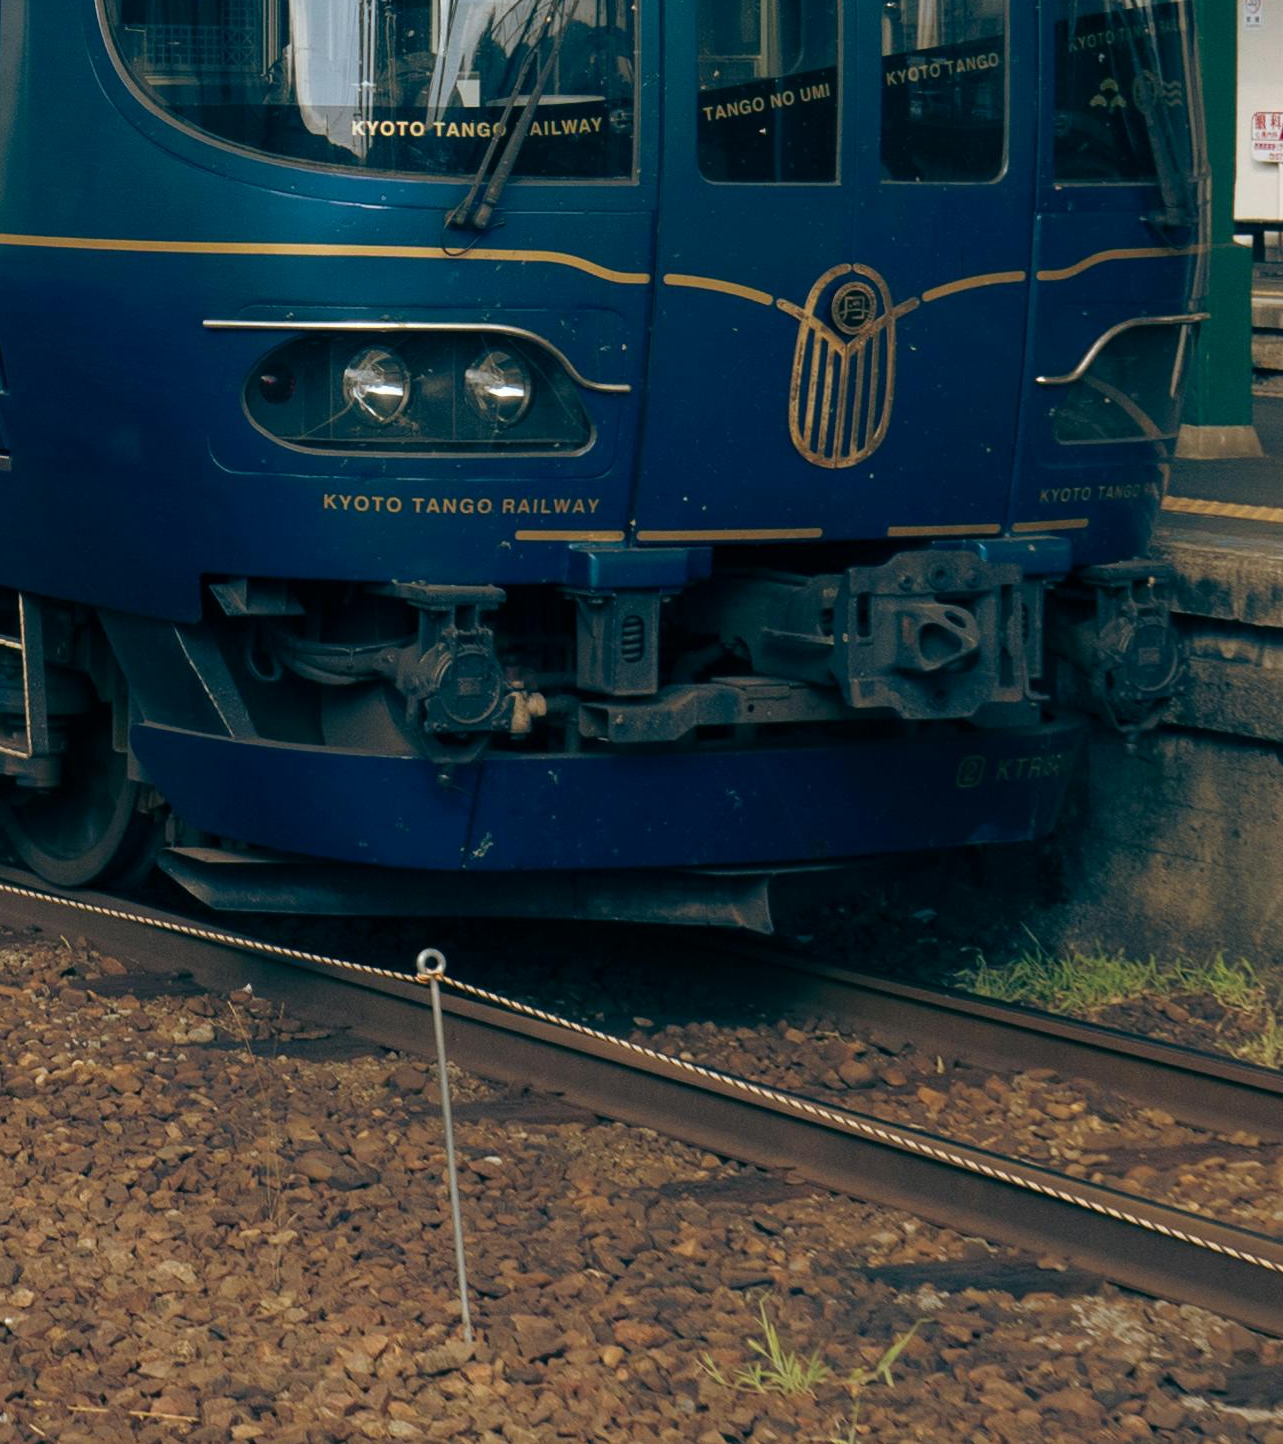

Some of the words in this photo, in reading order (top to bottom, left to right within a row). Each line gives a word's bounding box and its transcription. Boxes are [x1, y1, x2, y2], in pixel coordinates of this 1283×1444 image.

[886, 65, 940, 87] KYOTO
[947, 52, 999, 74] TANGO
[703, 96, 765, 121] TANGO
[770, 90, 795, 109] NO
[800, 83, 830, 103] UMI
[351, 120, 426, 137] KYOTO
[434, 121, 506, 138] TANGO
[520, 116, 602, 137] AILWAY
[323, 494, 402, 513] KYOTO
[412, 498, 492, 514] TANGO
[502, 498, 599, 514] RAILWAY
[1040, 486, 1092, 503] KYOTO
